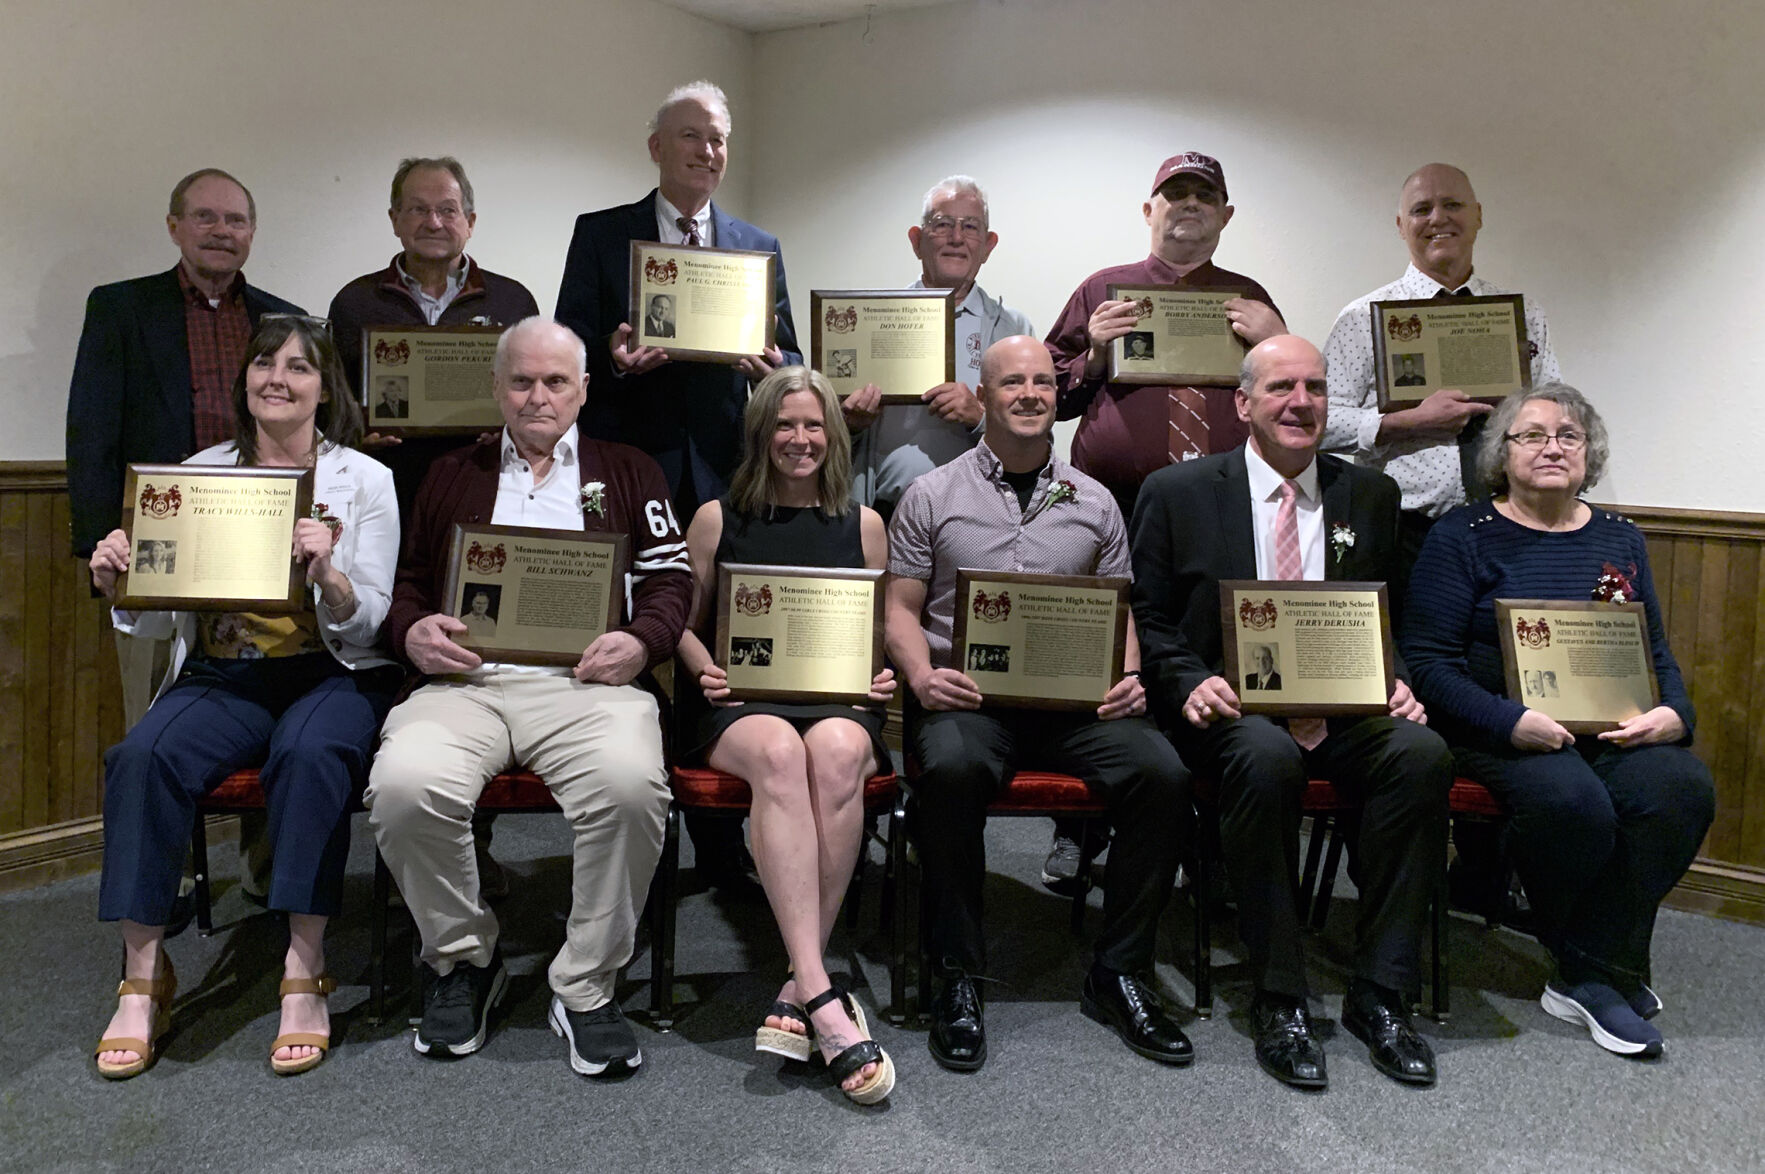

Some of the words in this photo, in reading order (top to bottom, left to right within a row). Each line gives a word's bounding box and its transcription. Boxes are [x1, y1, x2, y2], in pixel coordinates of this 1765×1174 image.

[902, 306, 918, 314] High
[880, 322, 896, 330] DON
[190, 486, 238, 495] Menominee
[263, 488, 291, 496] School
[193, 506, 224, 515] TRACY
[645, 498, 681, 538] 64
[513, 545, 561, 556] Menominee
[562, 549, 582, 559] High
[583, 551, 609, 560] School
[513, 556, 550, 565] ATHLETIC
[552, 559, 573, 567] HALL
[586, 561, 608, 569] FAME
[526, 566, 546, 574] BILL
[547, 568, 594, 578] SCHWANZ
[779, 585, 823, 595] Menominee
[824, 588, 843, 597] High
[845, 589, 870, 597] School
[779, 596, 815, 605] ATHLETIC
[816, 598, 836, 606] HALL
[1018, 593, 1063, 603] Menominee
[1065, 596, 1085, 605] High
[1086, 597, 1113, 606] School
[1329, 600, 1348, 609] High
[1019, 604, 1055, 612] ATHLETIC
[1090, 608, 1112, 616] FAME
[1295, 619, 1323, 627] JERRY
[1324, 619, 1367, 627] DERUSHA
[1554, 619, 1594, 627] Menominee
[1595, 620, 1612, 629] High
